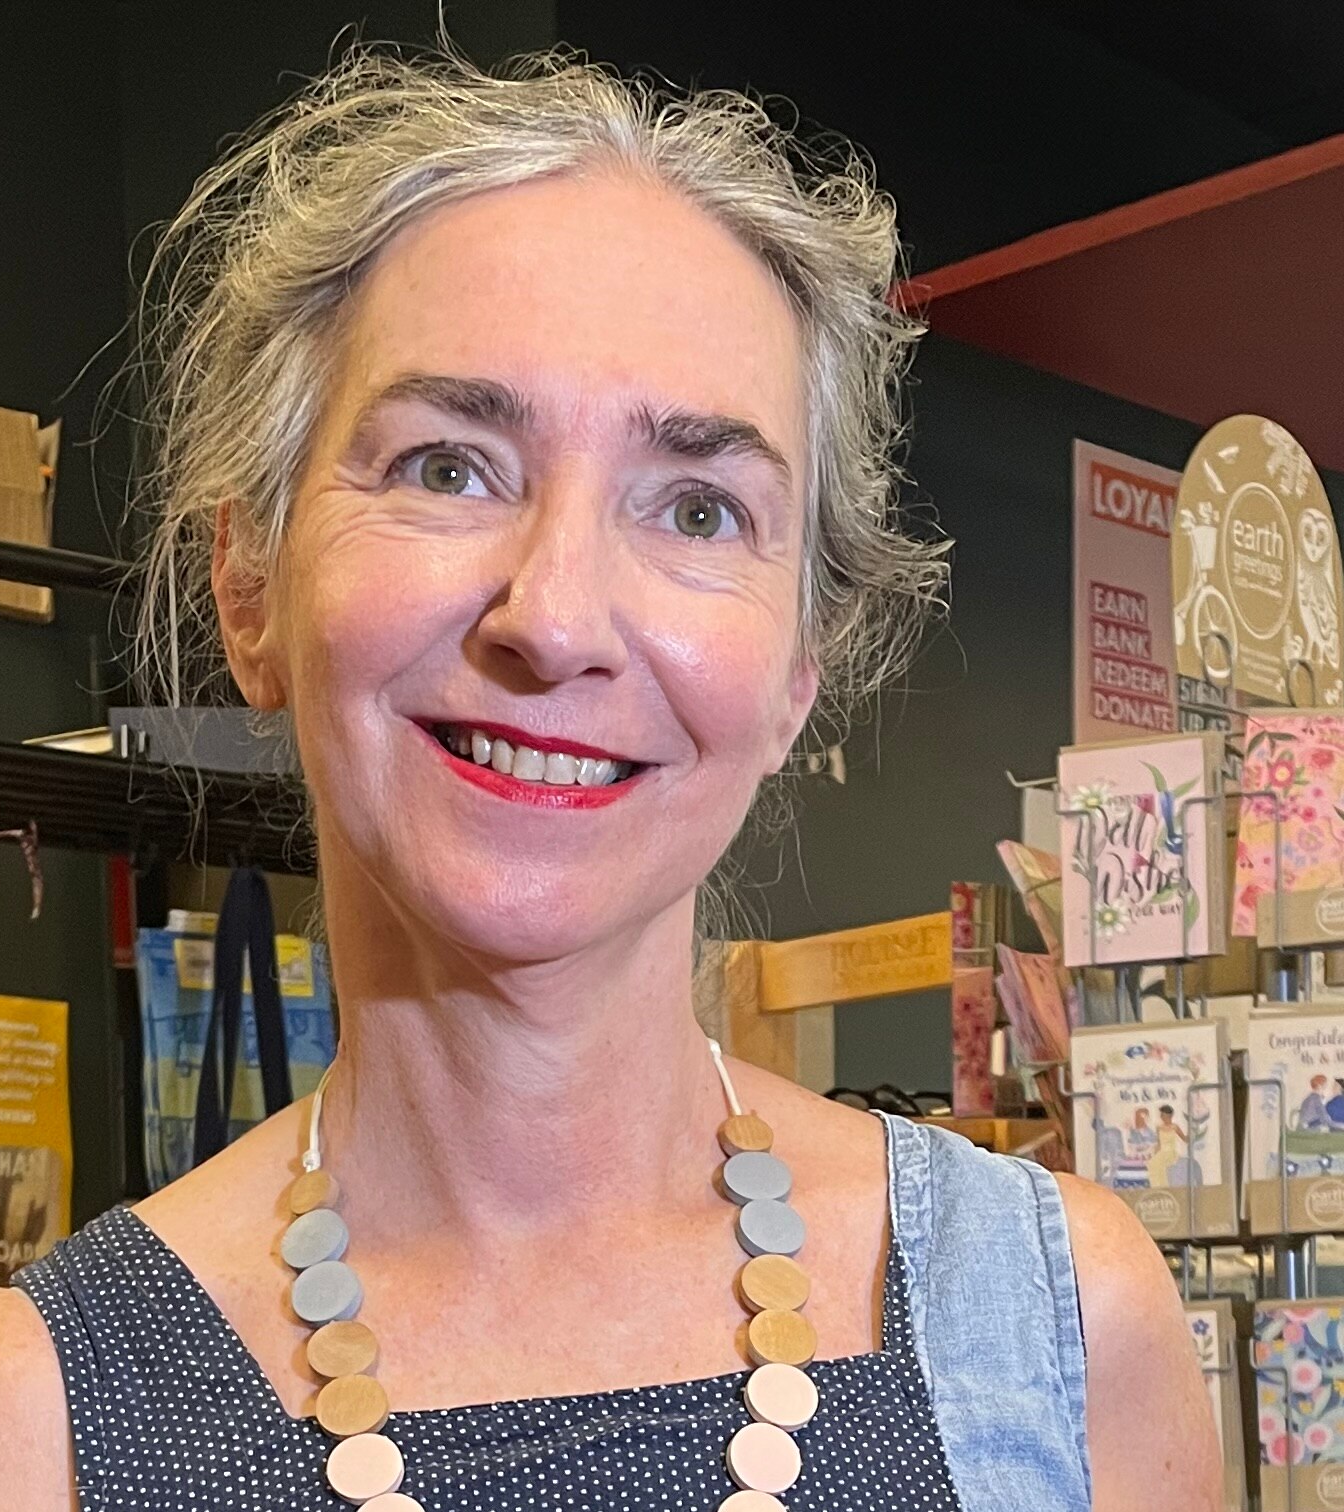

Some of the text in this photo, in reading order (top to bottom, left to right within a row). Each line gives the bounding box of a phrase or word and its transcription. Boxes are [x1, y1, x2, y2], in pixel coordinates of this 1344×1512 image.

[1233, 520, 1284, 560] earth
[1094, 587, 1145, 623] EARN
[1094, 622, 1150, 658] BANK
[1094, 659, 1167, 698] REDEEM
[1094, 693, 1173, 731] DONATE
